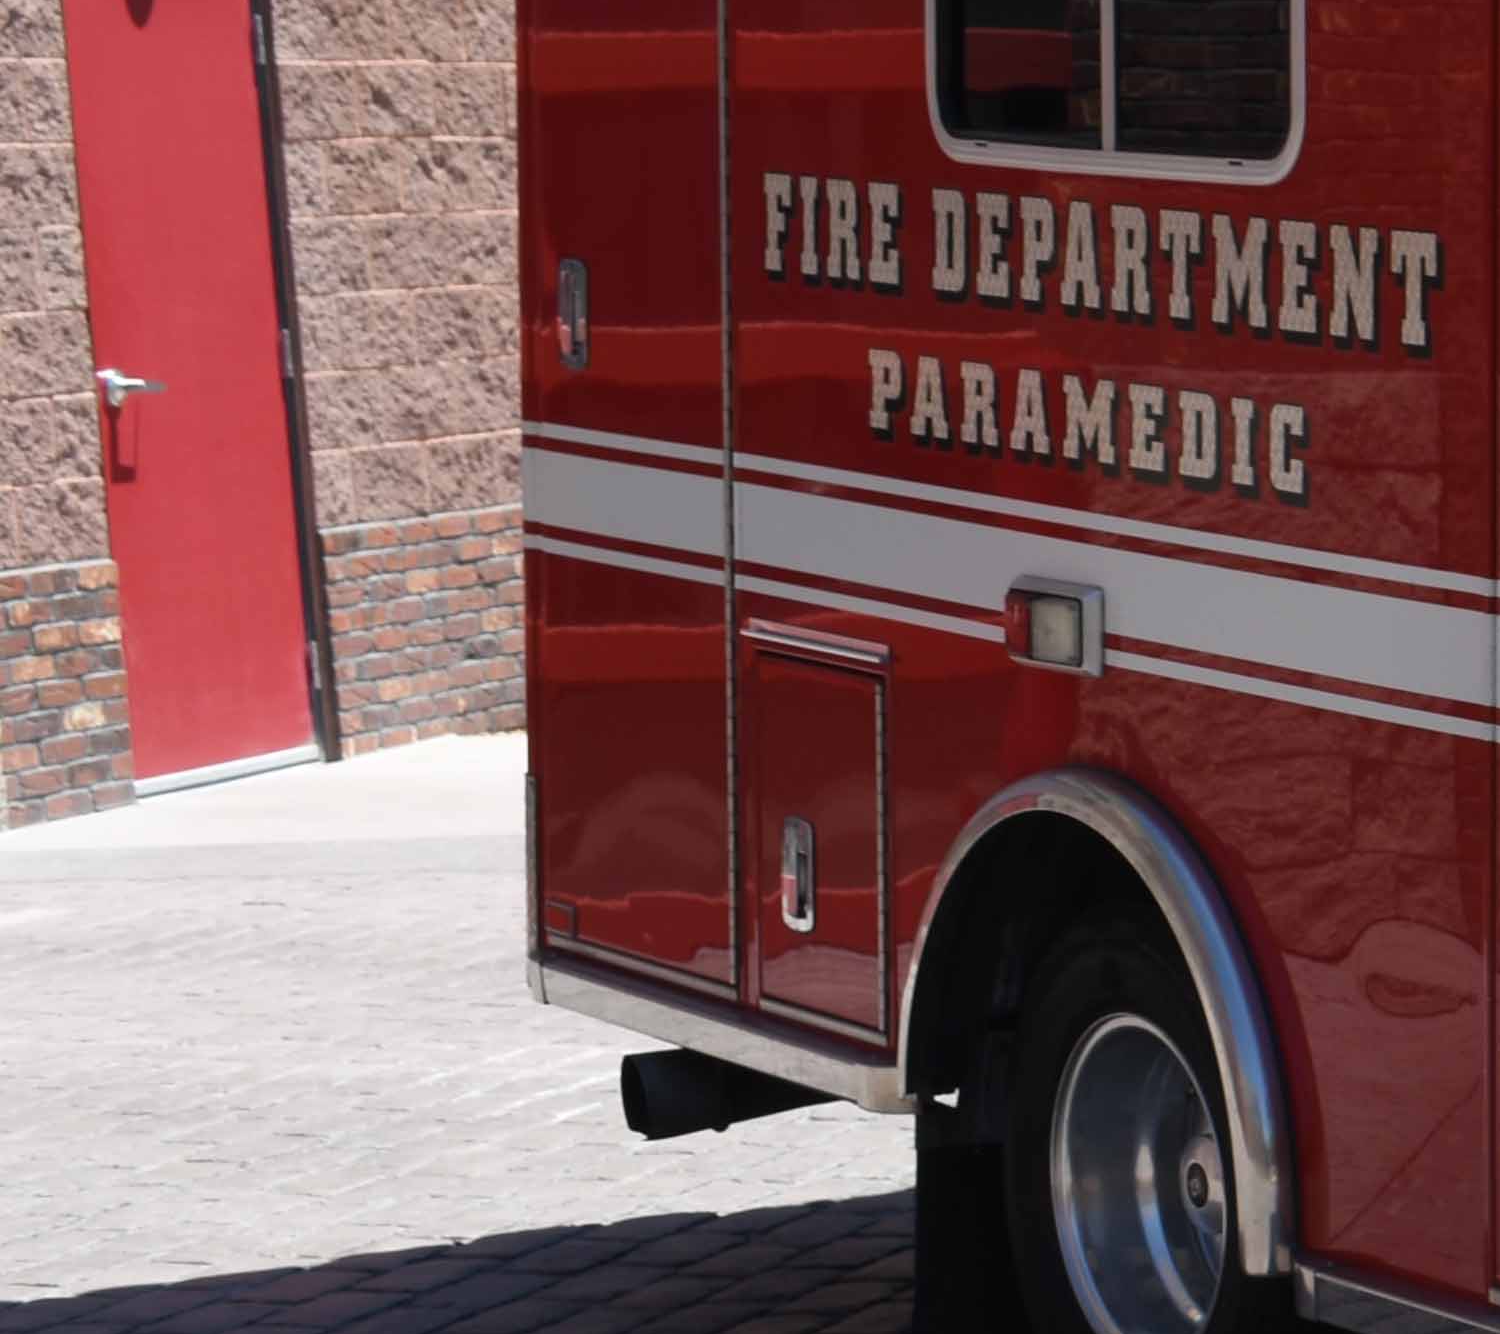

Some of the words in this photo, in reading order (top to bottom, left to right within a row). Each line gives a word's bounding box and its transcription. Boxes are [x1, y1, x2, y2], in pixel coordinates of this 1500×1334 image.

[763, 172, 901, 288] FIRE
[931, 187, 1440, 350] DEPARTMENT
[868, 349, 1307, 499] PARAMEDIC
